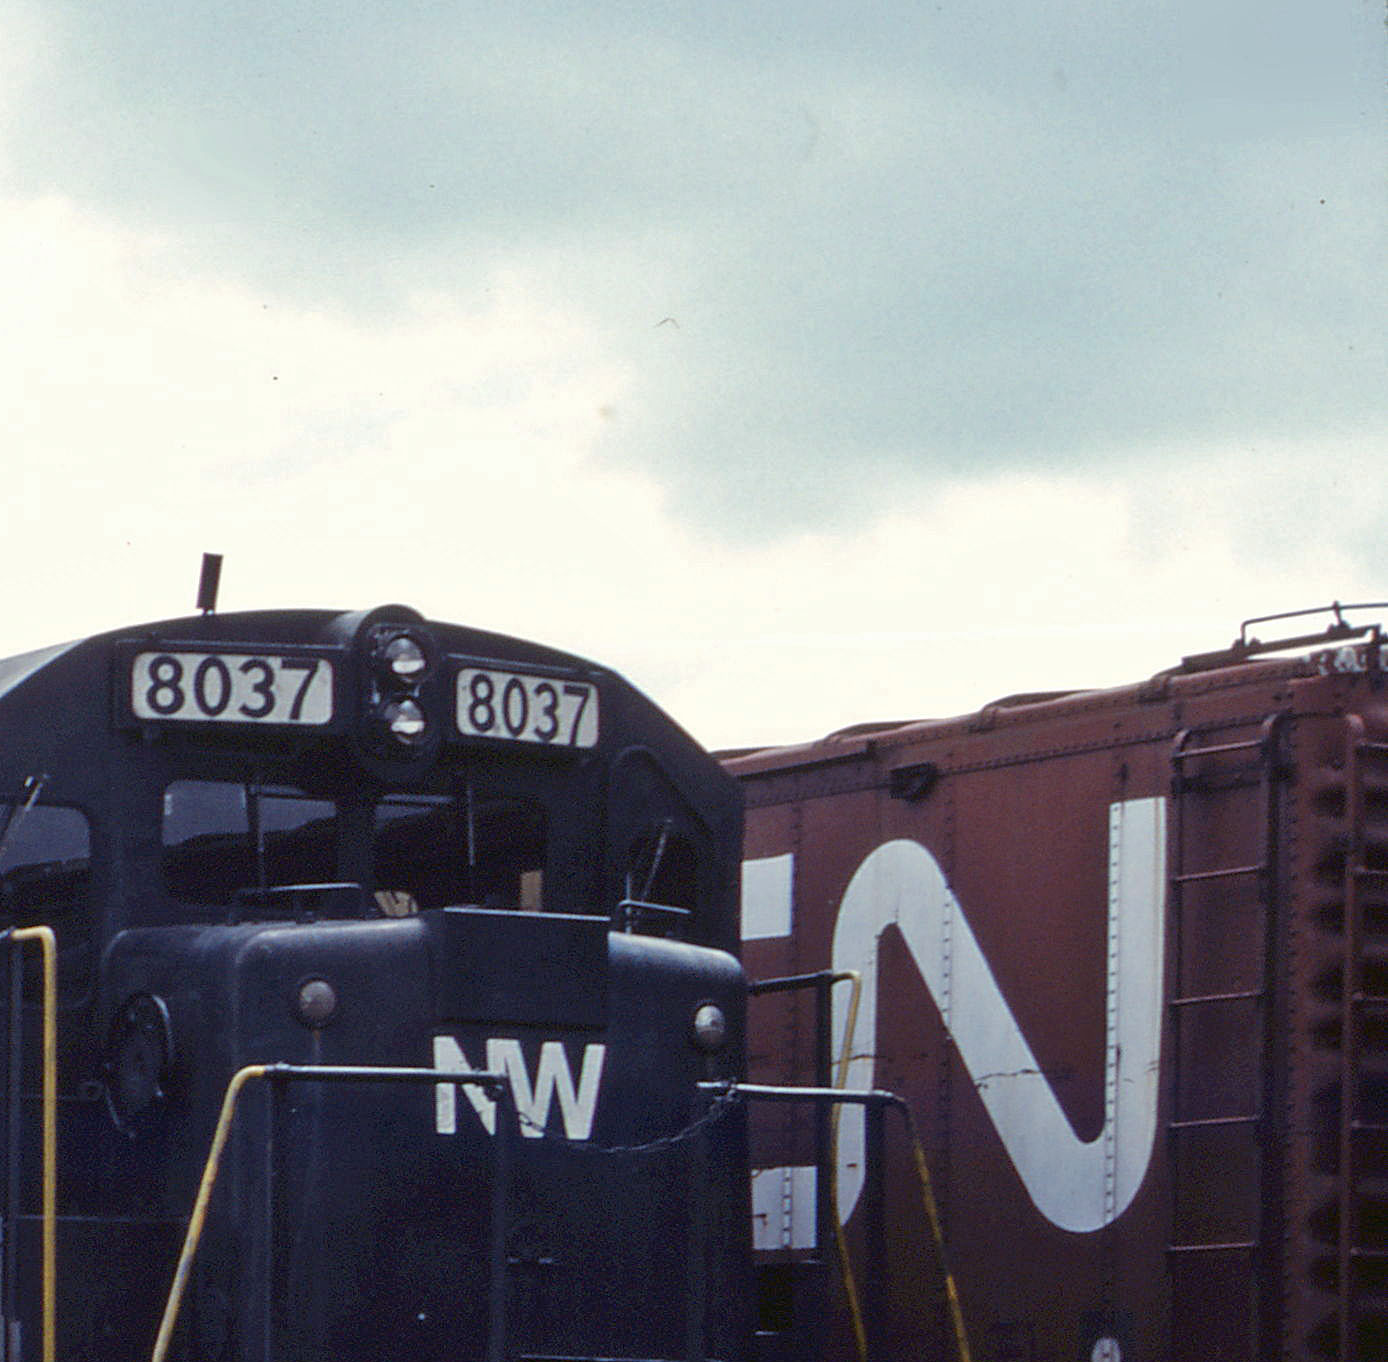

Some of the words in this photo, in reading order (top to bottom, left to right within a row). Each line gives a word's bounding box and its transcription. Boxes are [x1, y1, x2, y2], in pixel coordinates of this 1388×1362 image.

[145, 655, 321, 721] 8037
[467, 672, 592, 747] 8037
[740, 797, 1166, 1251] N
[433, 1035, 607, 1140] NW
